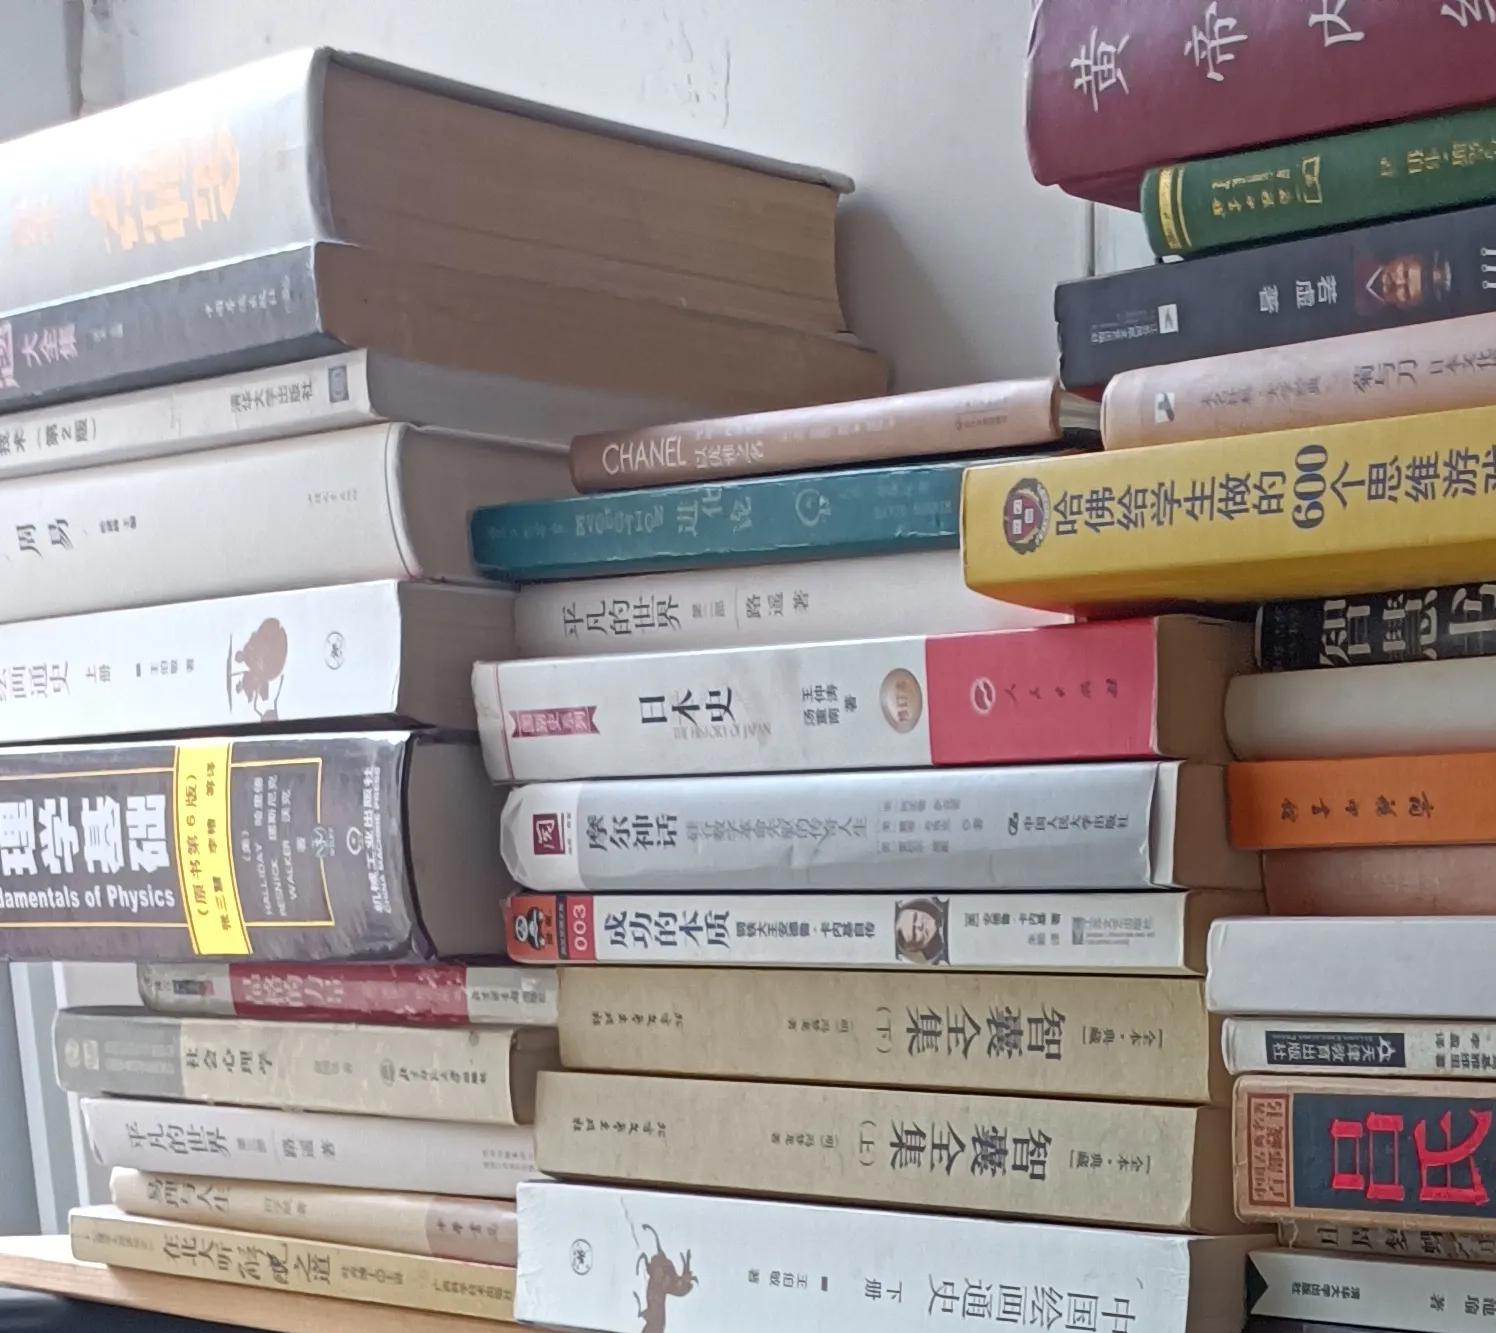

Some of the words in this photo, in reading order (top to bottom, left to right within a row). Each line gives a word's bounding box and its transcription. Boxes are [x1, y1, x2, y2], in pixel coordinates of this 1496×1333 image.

[1070, 0, 1496, 113] 黄帝内
[230, 374, 314, 416] 清华大学出版社
[1353, 357, 1418, 393] 菊与刀
[602, 434, 687, 475] CHANEL
[696, 440, 766, 471] 以优雅之名
[575, 502, 665, 540] EVOLUTION
[676, 485, 753, 538] 进化论
[9, 514, 71, 558] 周易
[561, 594, 681, 639] 平凡的世界
[745, 591, 785, 621] 路遥
[792, 588, 810, 612] 著
[85, 662, 112, 684] 上册
[638, 686, 734, 726] 日本史
[801, 683, 840, 704] 王仲涛
[843, 693, 858, 713] 著
[1022, 813, 1130, 833] 中国人民大学出版社
[1279, 790, 1436, 823] 商务印书馆
[0, 794, 171, 878] 理学基础
[585, 812, 679, 852] 摩尔神话
[254, 841, 274, 916] HALLIDAY
[281, 839, 298, 901] WALKER
[84, 884, 104, 910] of
[106, 882, 176, 915] Physics
[571, 903, 589, 953] 003
[601, 909, 731, 949] 成功的本质
[875, 1005, 892, 1054] （下）
[906, 1004, 1066, 1060] 智囊全集
[185, 1047, 275, 1076] 社会心理学
[1273, 1039, 1374, 1062] 天津教育出版社
[124, 1123, 233, 1157] 平凡的世界
[283, 1138, 315, 1159] 路遥
[320, 1138, 336, 1158] 著
[859, 1120, 875, 1167] （上）
[888, 1118, 1053, 1181] 智囊全集
[770, 1268, 808, 1292] 王伯敏
[862, 1276, 903, 1304] 下册
[1291, 1280, 1362, 1301] 清华大学出版社
[1430, 1292, 1446, 1313] 著
